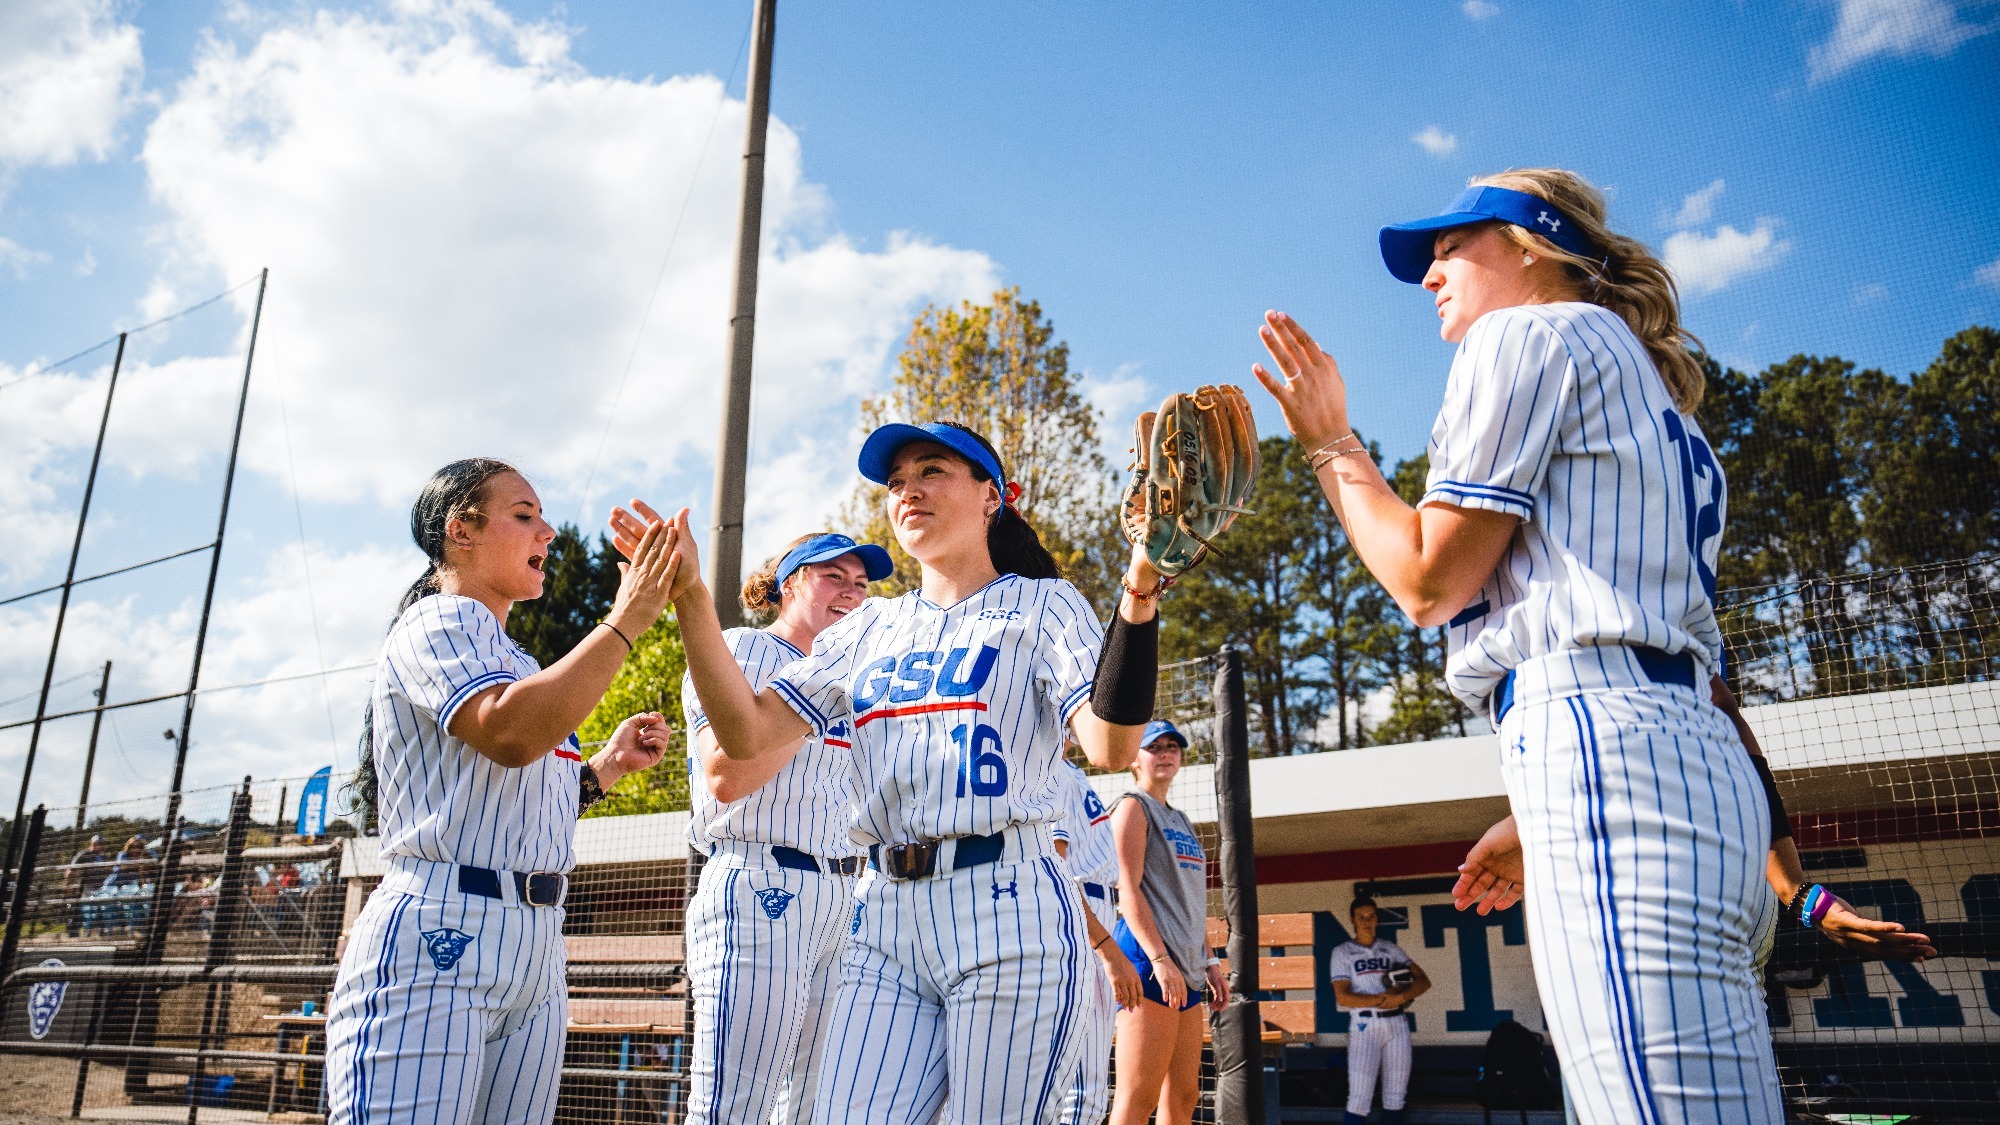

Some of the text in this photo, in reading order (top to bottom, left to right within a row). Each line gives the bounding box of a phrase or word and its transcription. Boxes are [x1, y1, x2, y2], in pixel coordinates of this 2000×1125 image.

[853, 645, 1000, 713] GSU
[951, 723, 1008, 798] 16
[1354, 957, 1390, 972] GSU
